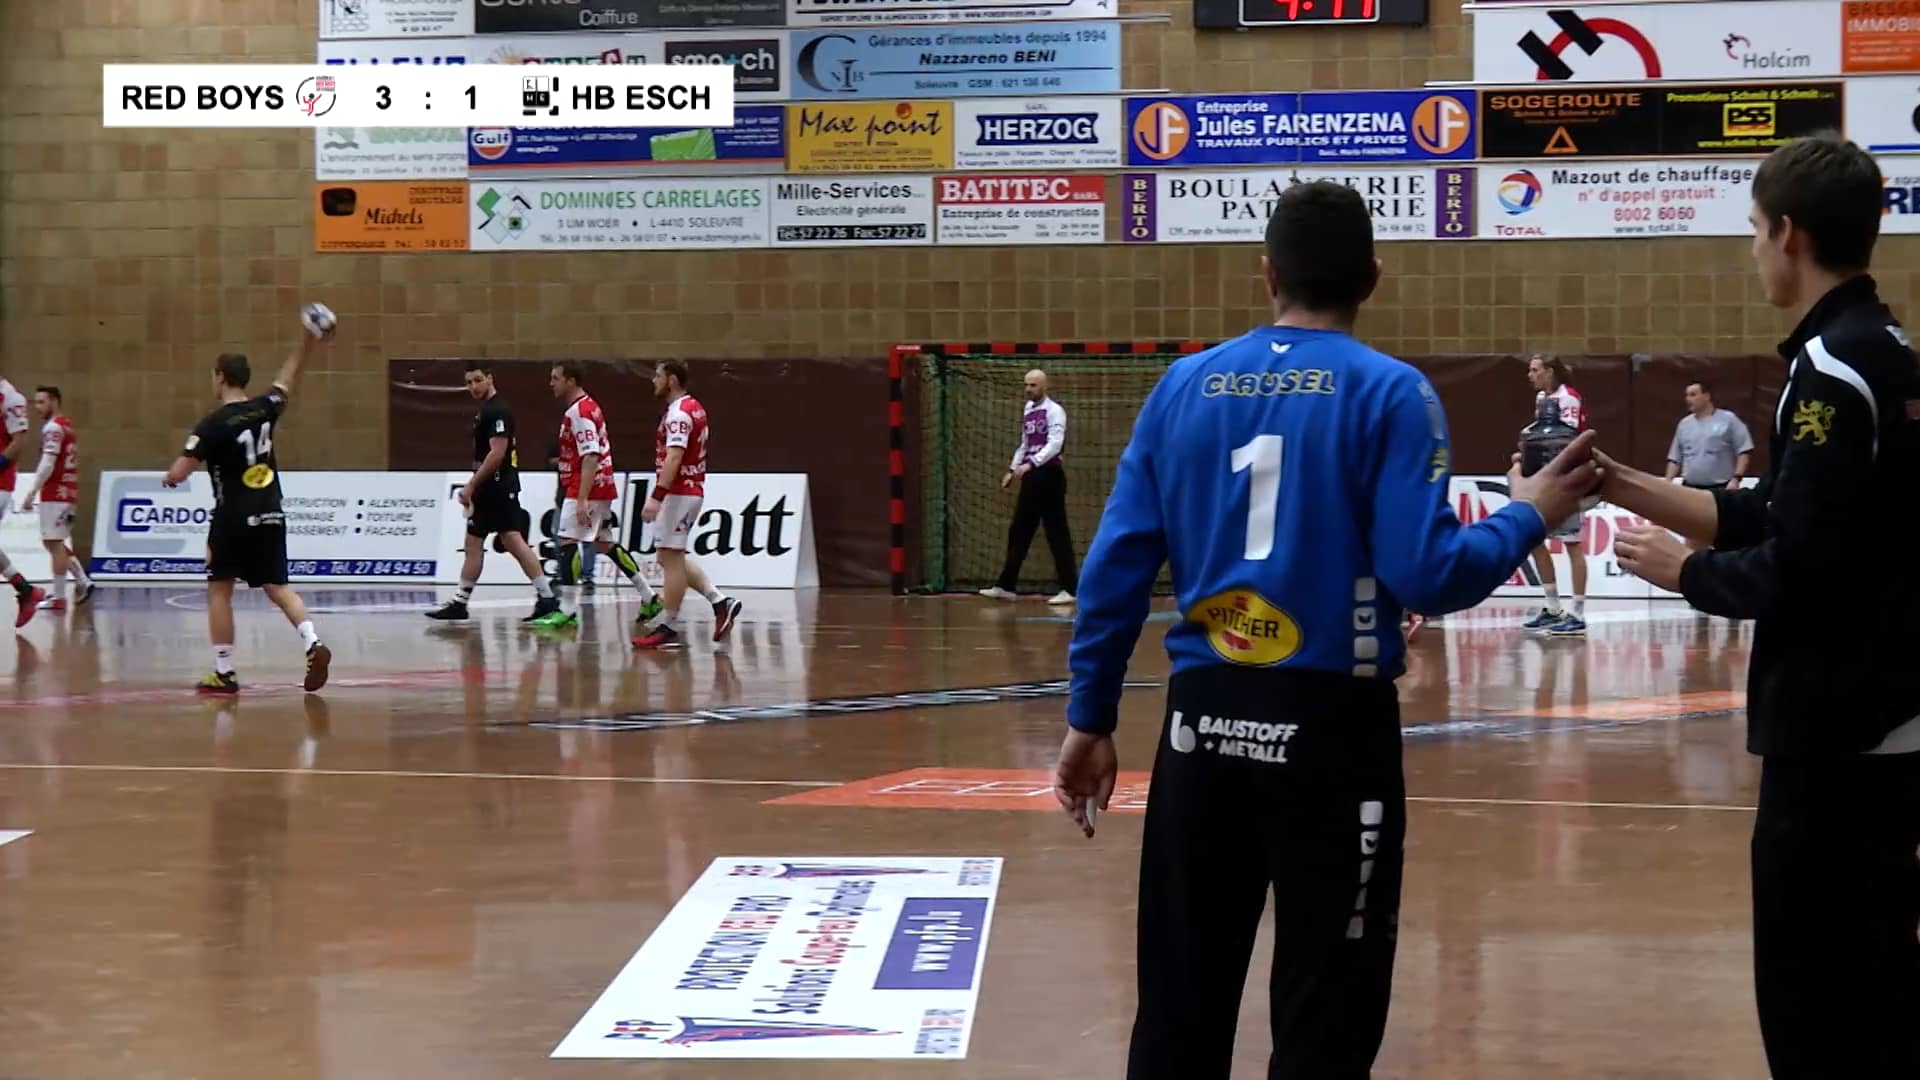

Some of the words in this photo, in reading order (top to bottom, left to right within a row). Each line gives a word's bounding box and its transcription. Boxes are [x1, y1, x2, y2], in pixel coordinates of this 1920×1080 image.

[869, 35, 933, 48] Gérances
[935, 33, 1022, 46] d'immeubles
[1026, 31, 1072, 46] depuis
[1077, 30, 1107, 43] 1994
[919, 52, 1009, 66] Nazzareno
[1014, 49, 1057, 63] BENI
[1742, 48, 1811, 69] Holcim
[1195, 100, 1268, 115] Entreprise
[1490, 93, 1641, 110] SOGEROUTE
[1195, 115, 1256, 137] Jules
[1262, 112, 1406, 134] FARENZENA
[1728, 107, 1771, 124] PSS
[799, 107, 858, 138] Max
[864, 108, 943, 146] point
[984, 117, 1092, 141] HERZOG
[473, 132, 509, 145] Gulf
[1195, 137, 1263, 148] TRAVAUX
[1266, 136, 1329, 147] PUBLICS
[1332, 136, 1350, 145] ET
[1353, 135, 1408, 145] PRIVES
[1552, 169, 1621, 184] Mazout
[1628, 168, 1650, 183] de
[1656, 165, 1752, 184] chauffage
[777, 183, 912, 201] Mille-Services
[941, 178, 1071, 202] BATITEC
[1168, 175, 1425, 199] BOULAERIE
[1599, 187, 1655, 203] d'appel
[1660, 186, 1715, 203] gratuit
[643, 189, 761, 209] CARRELAGES
[1130, 178, 1149, 238] BERTO
[1444, 173, 1463, 233] BERTO
[364, 207, 424, 225] Michels
[857, 205, 906, 218] générale
[942, 208, 1003, 220] Entreprise
[1007, 208, 1020, 218] de
[1024, 207, 1100, 218] construction
[1614, 207, 1651, 221] 8002
[1657, 206, 1694, 220] 6060
[688, 216, 744, 229] SOLEUVRE
[1493, 224, 1545, 236] TOTAL
[1201, 368, 1336, 398] CLAUSEL
[237, 421, 273, 467] 14
[284, 498, 348, 508] STRUCTION
[368, 497, 437, 508] ALENTOURS
[1230, 434, 1283, 560] 1
[284, 512, 336, 522] ONNAGE
[366, 511, 408, 522] TOITURE
[286, 525, 349, 535] ASSEMENT
[123, 561, 148, 572] rue
[288, 560, 317, 574] URG
[357, 560, 371, 574] 27
[375, 560, 392, 573] 84
[393, 560, 410, 573] 94
[1207, 606, 1281, 640] PITCHER
[1197, 715, 1298, 743] BAUSTOFF
[1217, 738, 1288, 763] METALL
[675, 931, 771, 989] PROTECTION
[730, 895, 793, 911] PRO
[904, 909, 975, 971] www.pfp.lu
[752, 968, 838, 1013] Solutions
